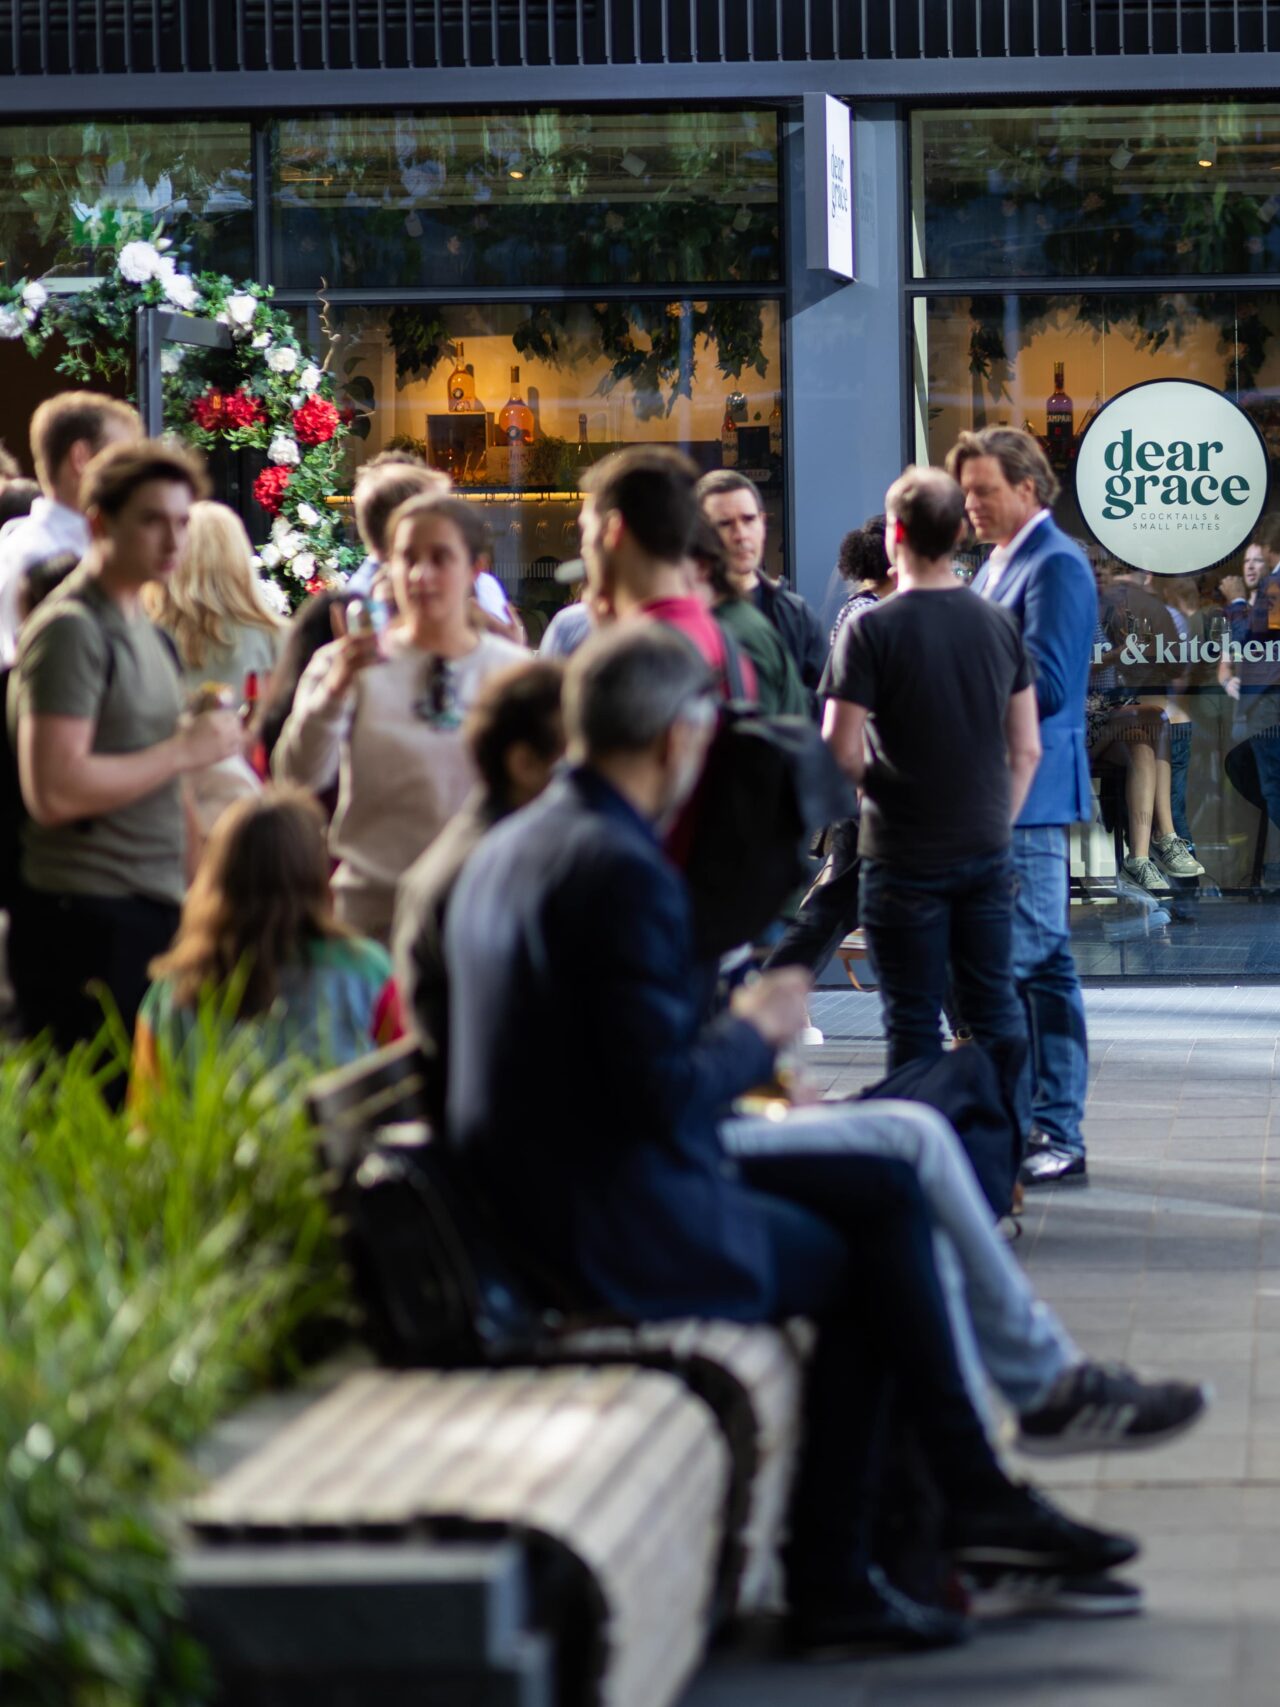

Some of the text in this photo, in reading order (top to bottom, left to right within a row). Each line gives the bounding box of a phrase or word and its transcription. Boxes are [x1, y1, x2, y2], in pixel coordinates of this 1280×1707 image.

[831, 144, 844, 183] dear
[831, 182, 848, 218] grace
[1103, 429, 1223, 471] dear
[1102, 473, 1250, 519] grace
[1140, 512, 1220, 520] COCKTAILS &
[1177, 523, 1220, 531] PLATES
[1120, 633, 1150, 665] &
